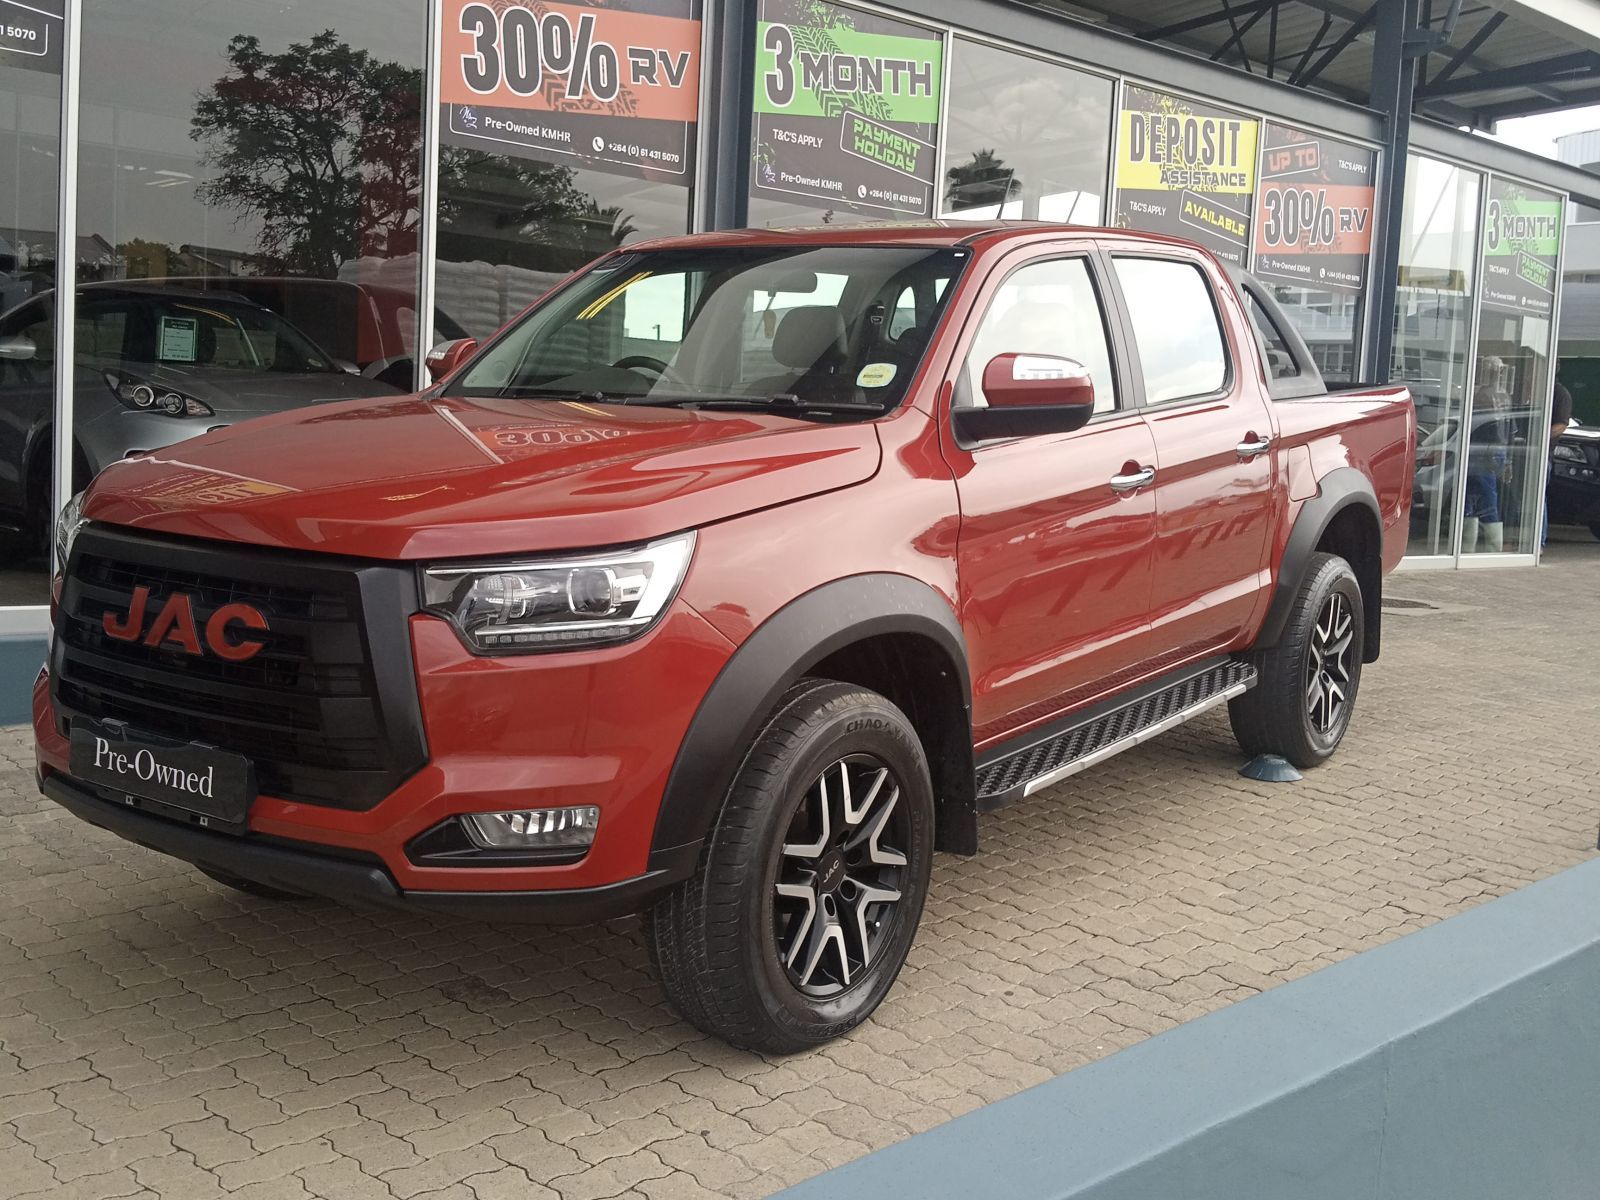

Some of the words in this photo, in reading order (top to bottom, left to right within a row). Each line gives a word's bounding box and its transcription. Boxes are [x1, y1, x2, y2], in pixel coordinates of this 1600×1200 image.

[7, 26, 36, 40] 5070
[459, 2, 620, 102] 30%
[627, 46, 691, 88] RV
[764, 23, 796, 108] 3
[799, 50, 932, 97] MONTH
[485, 116, 540, 136] Pre-Owned
[541, 127, 571, 142] KMHR
[797, 134, 823, 148] APPLY
[853, 119, 921, 158] PAYMENT
[1129, 113, 1242, 167] DEPOSIT
[608, 143, 627, 153] +264
[628, 145, 639, 157] (0)
[649, 150, 661, 159] 431
[662, 153, 680, 163] 5070
[854, 136, 916, 173] HOLIDAY
[1268, 151, 1291, 172] UP
[1295, 147, 1317, 168] TO
[781, 172, 820, 187] Pre-Owned
[821, 179, 843, 191] KMHR
[1159, 169, 1247, 187] ASSISTANCE
[1147, 205, 1167, 216] APPLY
[1184, 201, 1245, 237] AVAILABLE
[1264, 187, 1335, 246] 30%
[1339, 206, 1369, 233] RV
[1487, 199, 1501, 251] 3
[1502, 215, 1557, 240] MONTH
[102, 585, 270, 661] JAC
[93, 736, 214, 798] Pre-Owned
[823, 859, 840, 883] JAC
